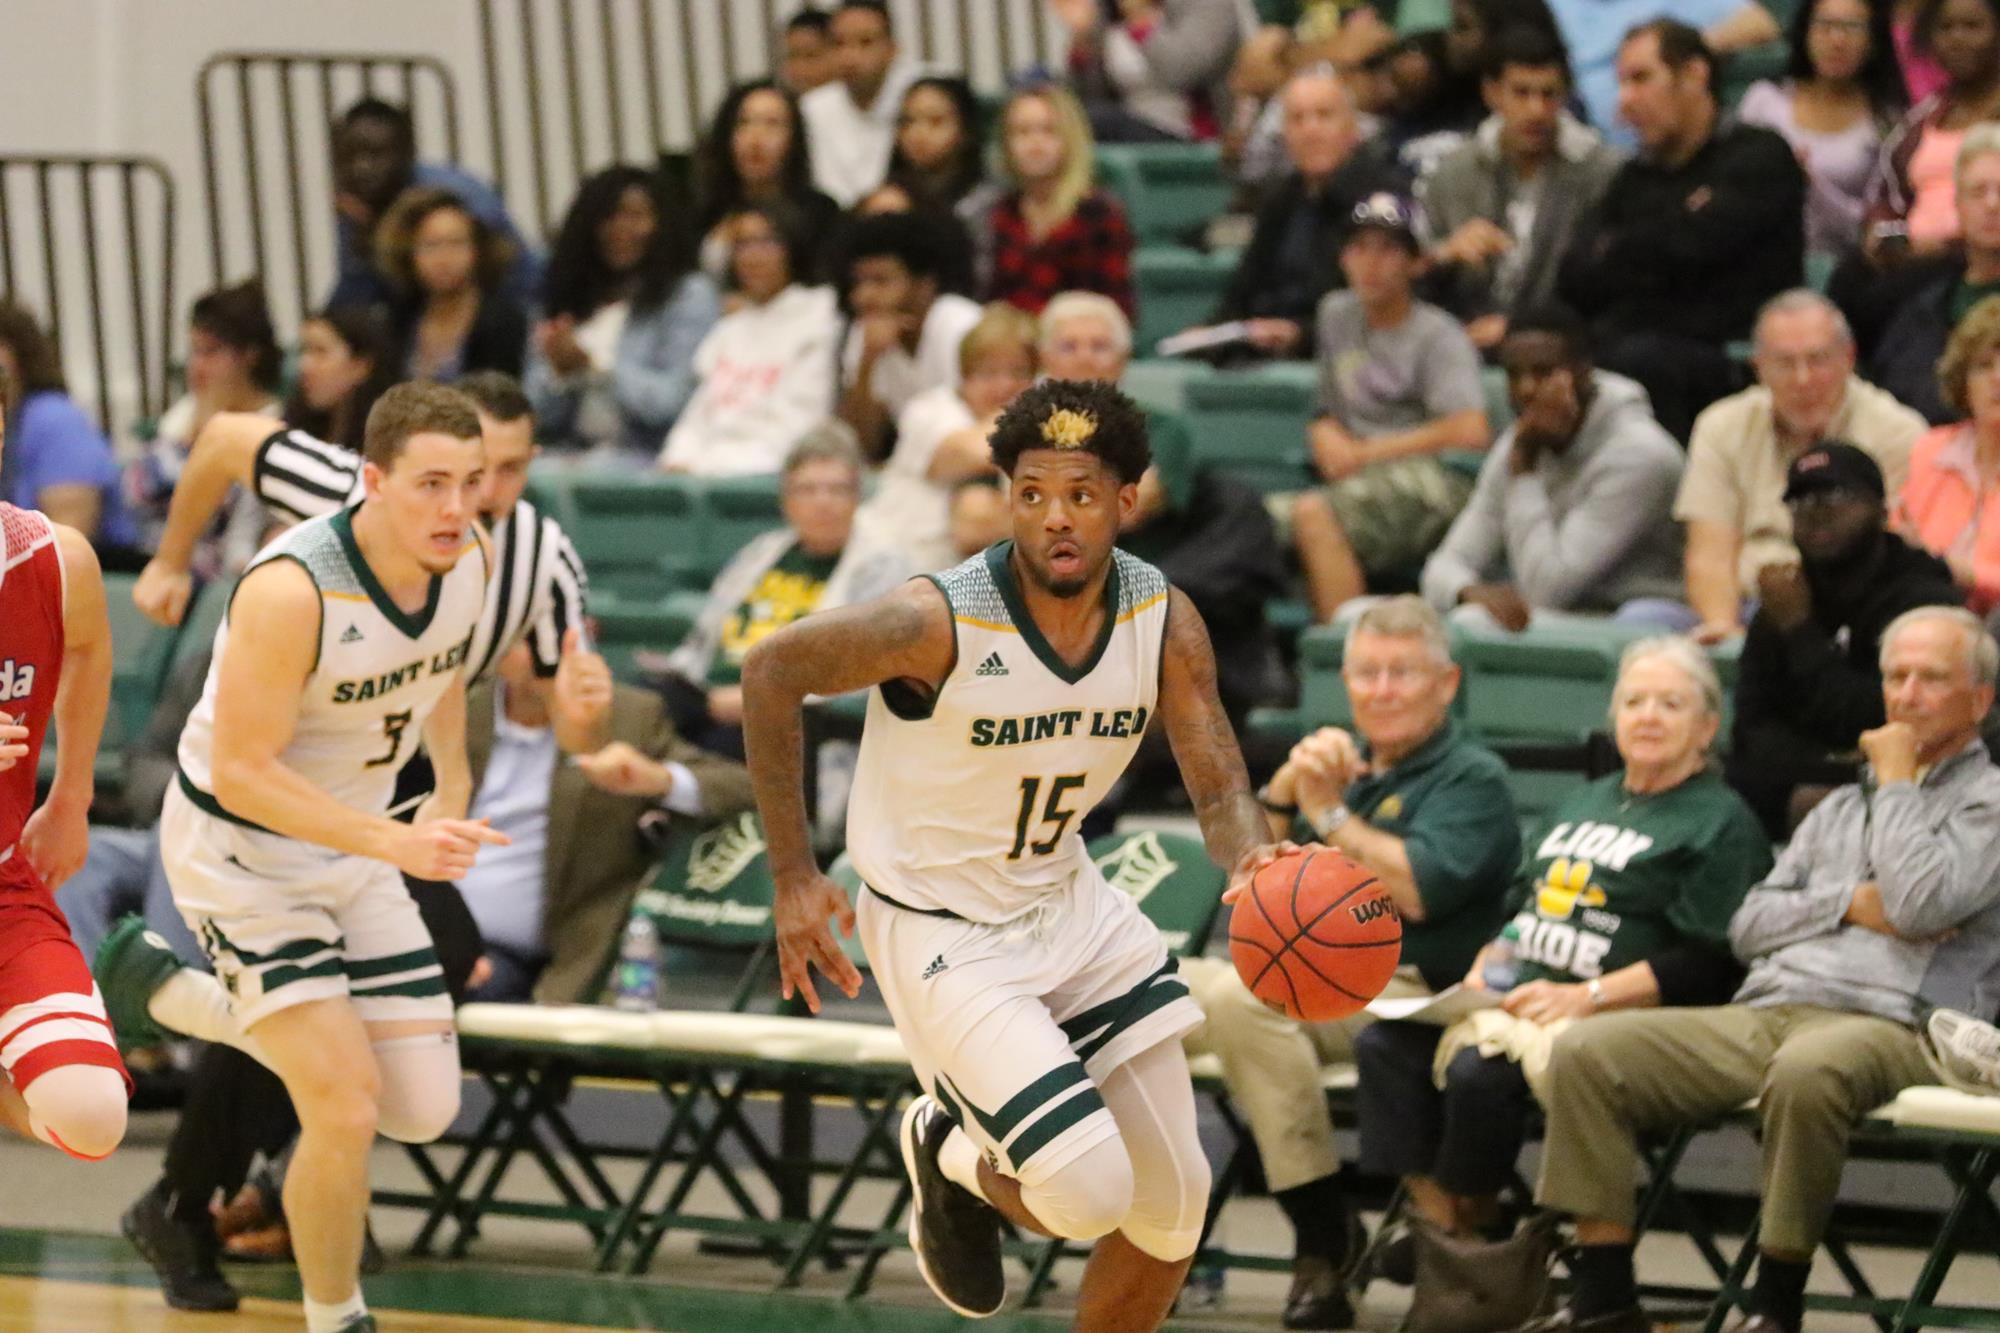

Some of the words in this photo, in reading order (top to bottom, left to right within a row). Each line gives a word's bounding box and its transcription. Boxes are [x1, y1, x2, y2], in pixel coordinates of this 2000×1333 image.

[331, 660, 424, 703] SAINT
[975, 667, 1009, 677] adidas
[970, 710, 1083, 747] SAINT
[1089, 706, 1149, 739] LEO
[1007, 771, 1088, 860] 15
[1536, 820, 1654, 873] LION
